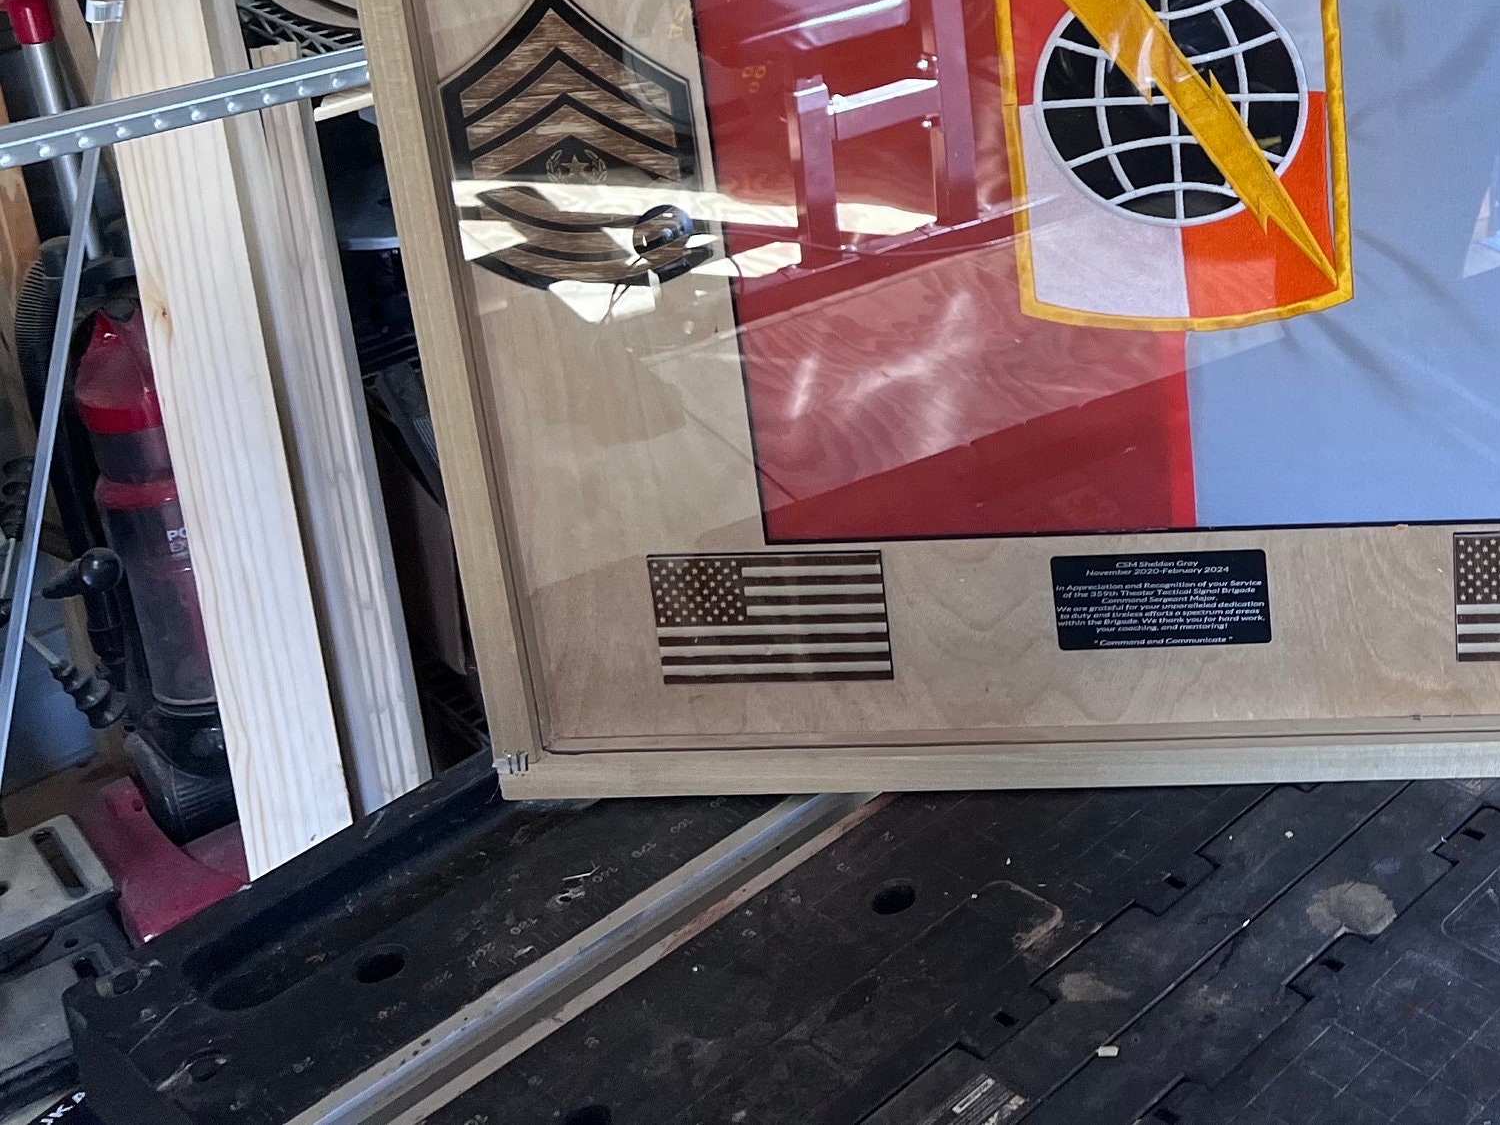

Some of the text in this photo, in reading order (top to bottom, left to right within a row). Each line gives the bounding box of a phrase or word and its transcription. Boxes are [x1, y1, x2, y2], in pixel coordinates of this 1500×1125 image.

[1139, 560, 1174, 568] Sheldon
[1066, 584, 1123, 592] Appreciation
[1193, 587, 1220, 595] Signal
[1221, 587, 1256, 595] Brigade
[1089, 604, 1124, 612] grateful
[1140, 603, 1160, 611] your
[1182, 609, 1224, 617] spectrum
[1096, 626, 1116, 634] your
